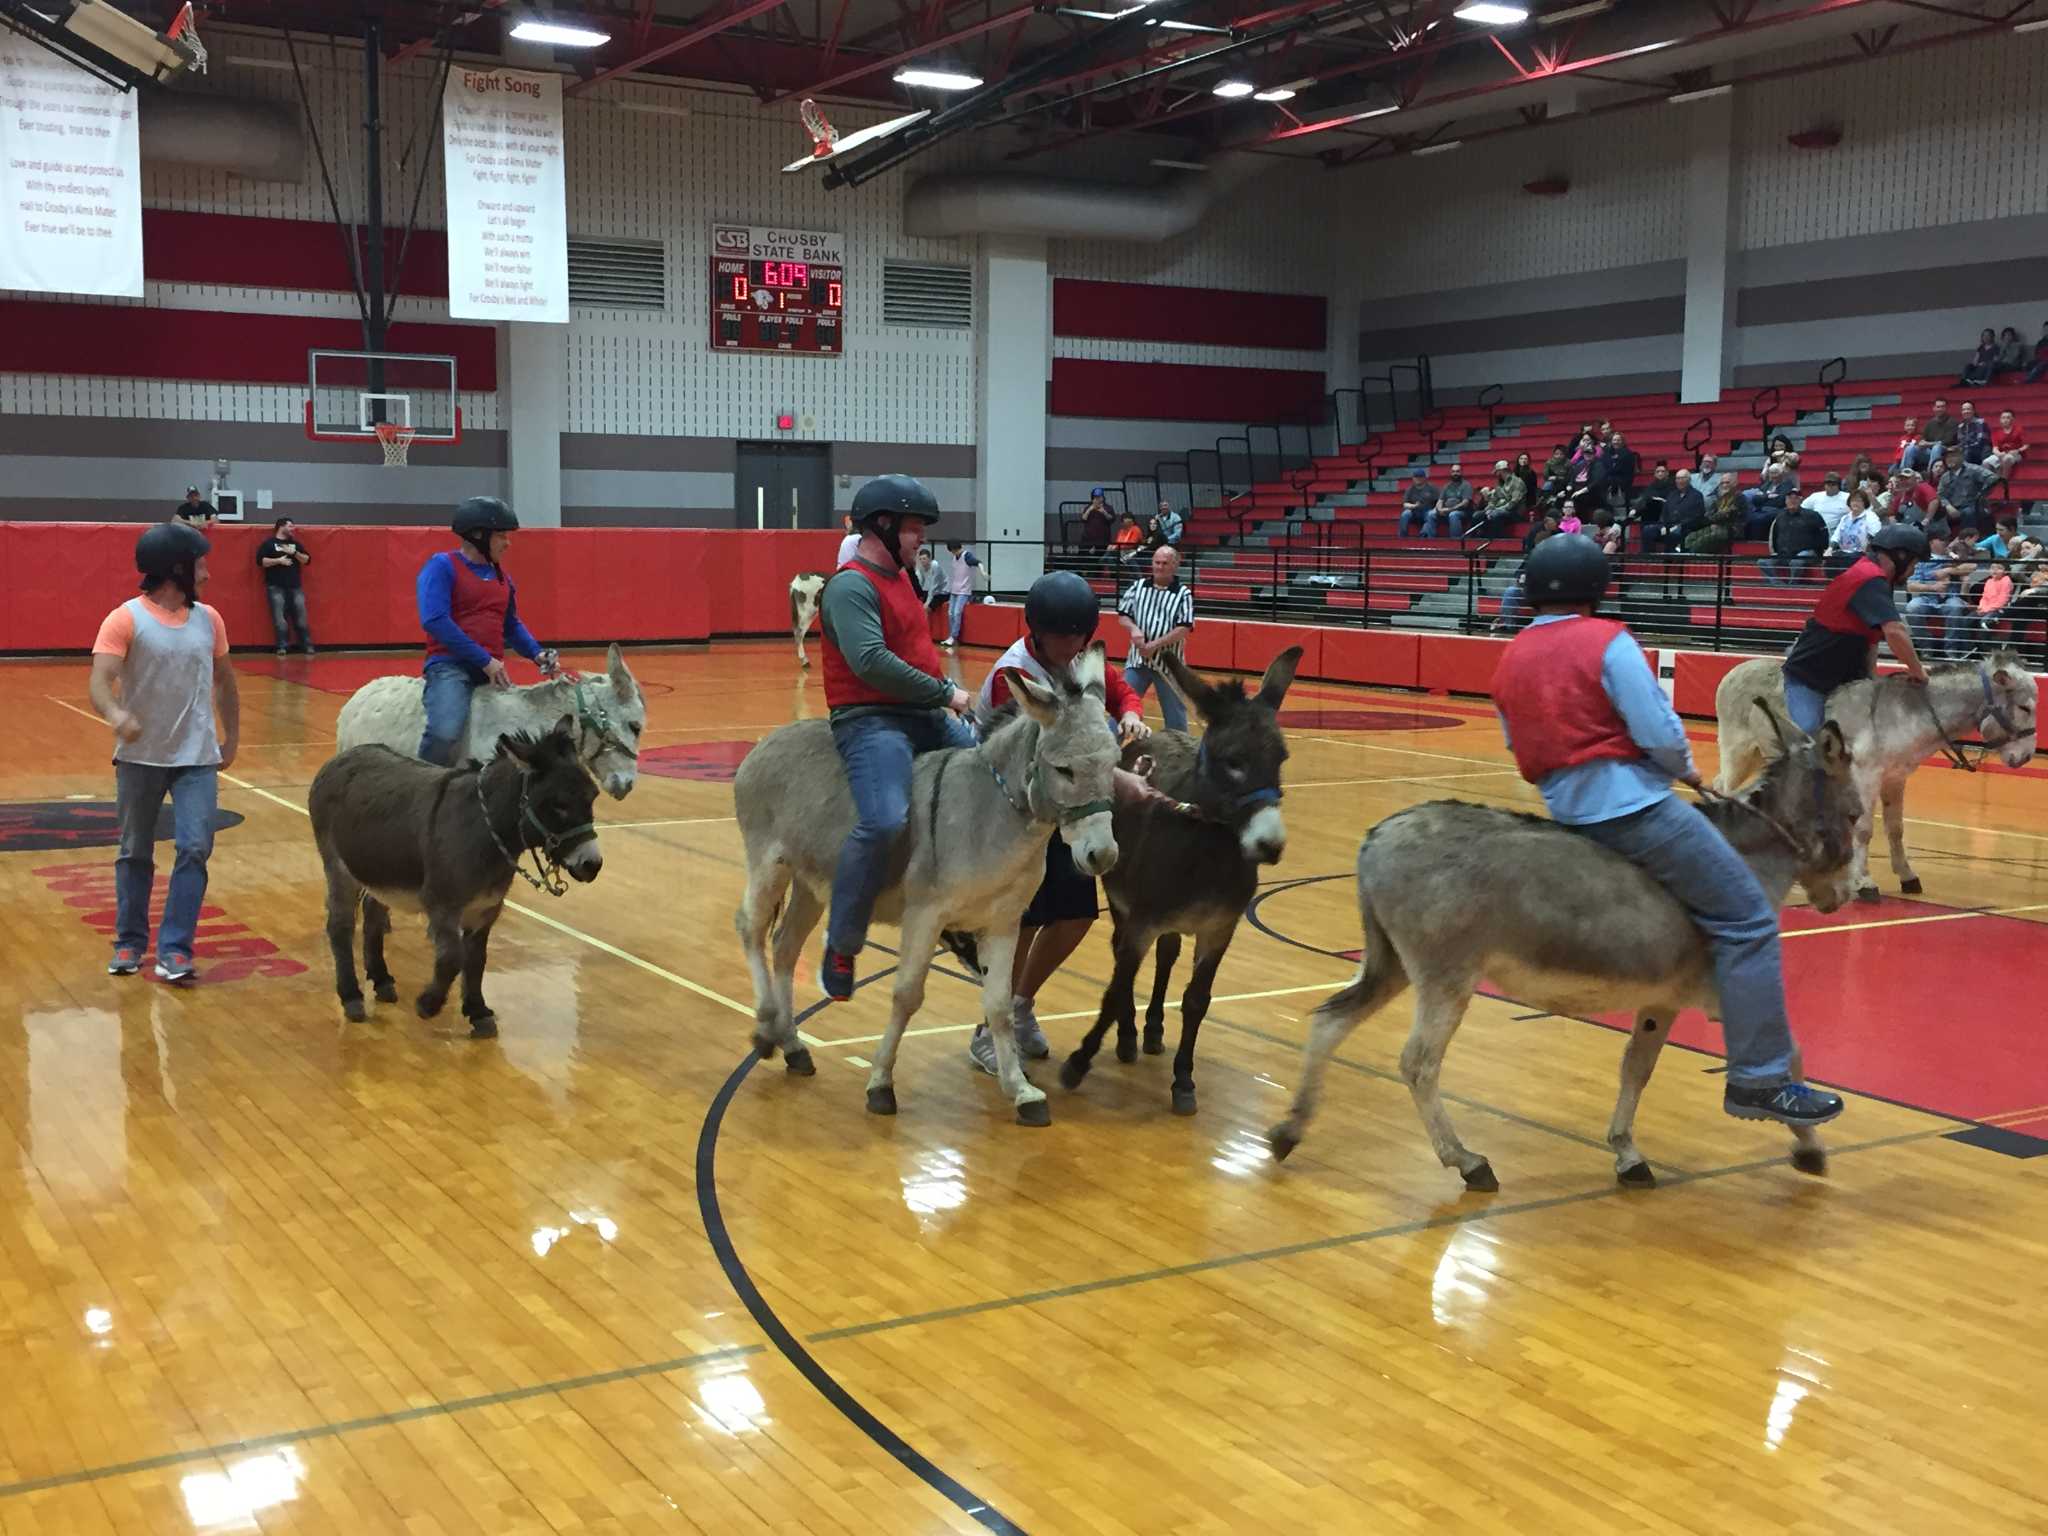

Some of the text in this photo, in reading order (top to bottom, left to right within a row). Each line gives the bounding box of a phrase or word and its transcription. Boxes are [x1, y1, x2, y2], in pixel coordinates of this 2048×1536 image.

[464, 72, 541, 99] Fight Song
[716, 230, 750, 249] CSB
[753, 243, 841, 263] STATE BANK
[718, 262, 745, 274] HOME
[810, 269, 842, 281] VISITOR
[734, 276, 748, 300] 0
[829, 283, 842, 307] 0
